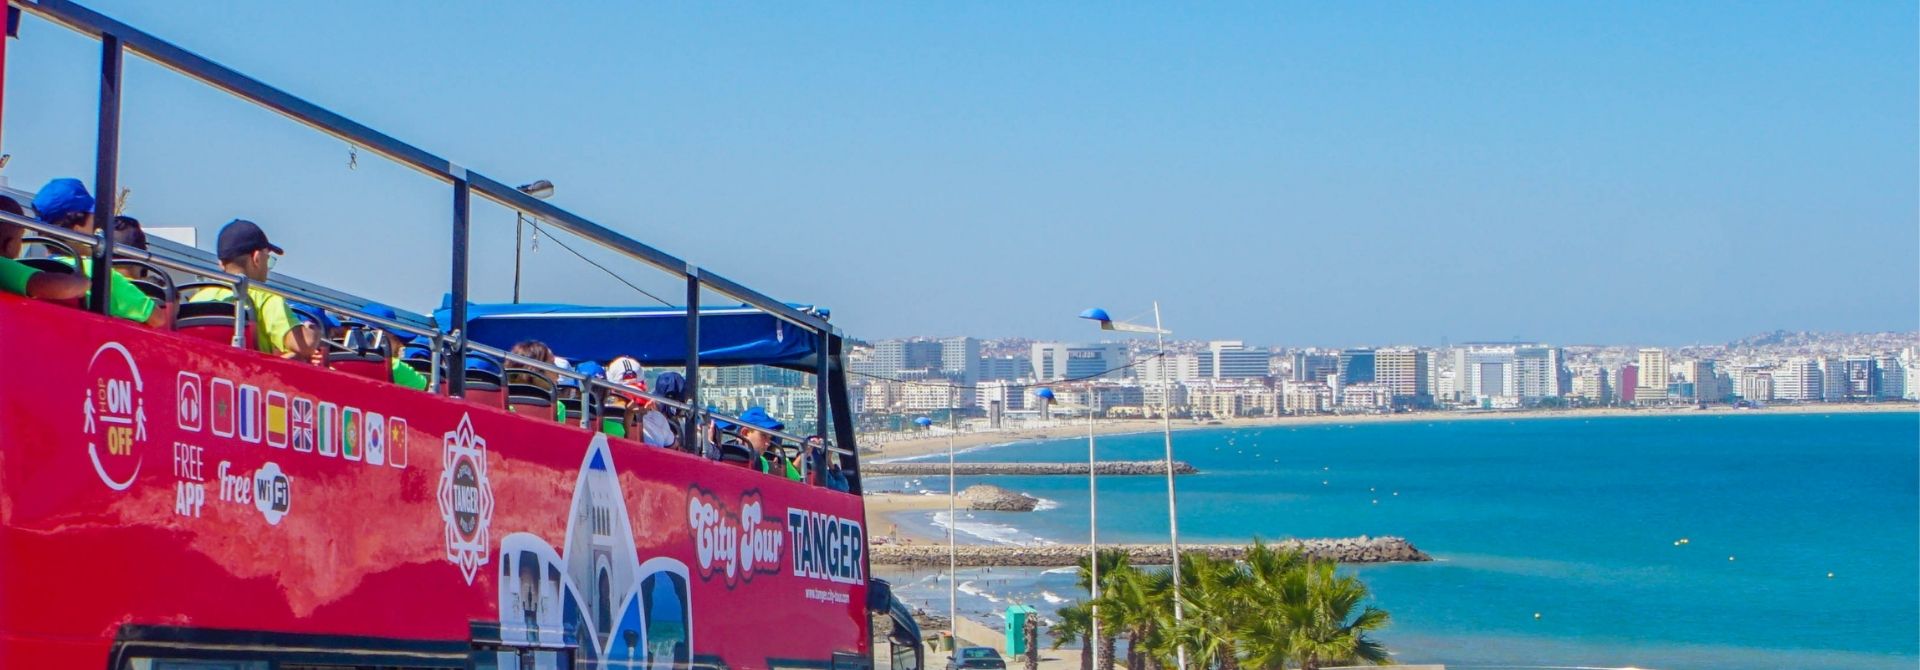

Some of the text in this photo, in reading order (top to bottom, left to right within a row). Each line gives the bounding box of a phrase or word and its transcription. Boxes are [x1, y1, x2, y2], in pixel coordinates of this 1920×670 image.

[98, 377, 107, 412] HOP
[107, 378, 132, 414] ON
[108, 426, 133, 455] OFF
[173, 441, 205, 481] FREE
[175, 480, 205, 518] APP
[453, 484, 479, 514] TANGER
[689, 496, 783, 578] City Tour
[788, 507, 864, 586] TANGER
